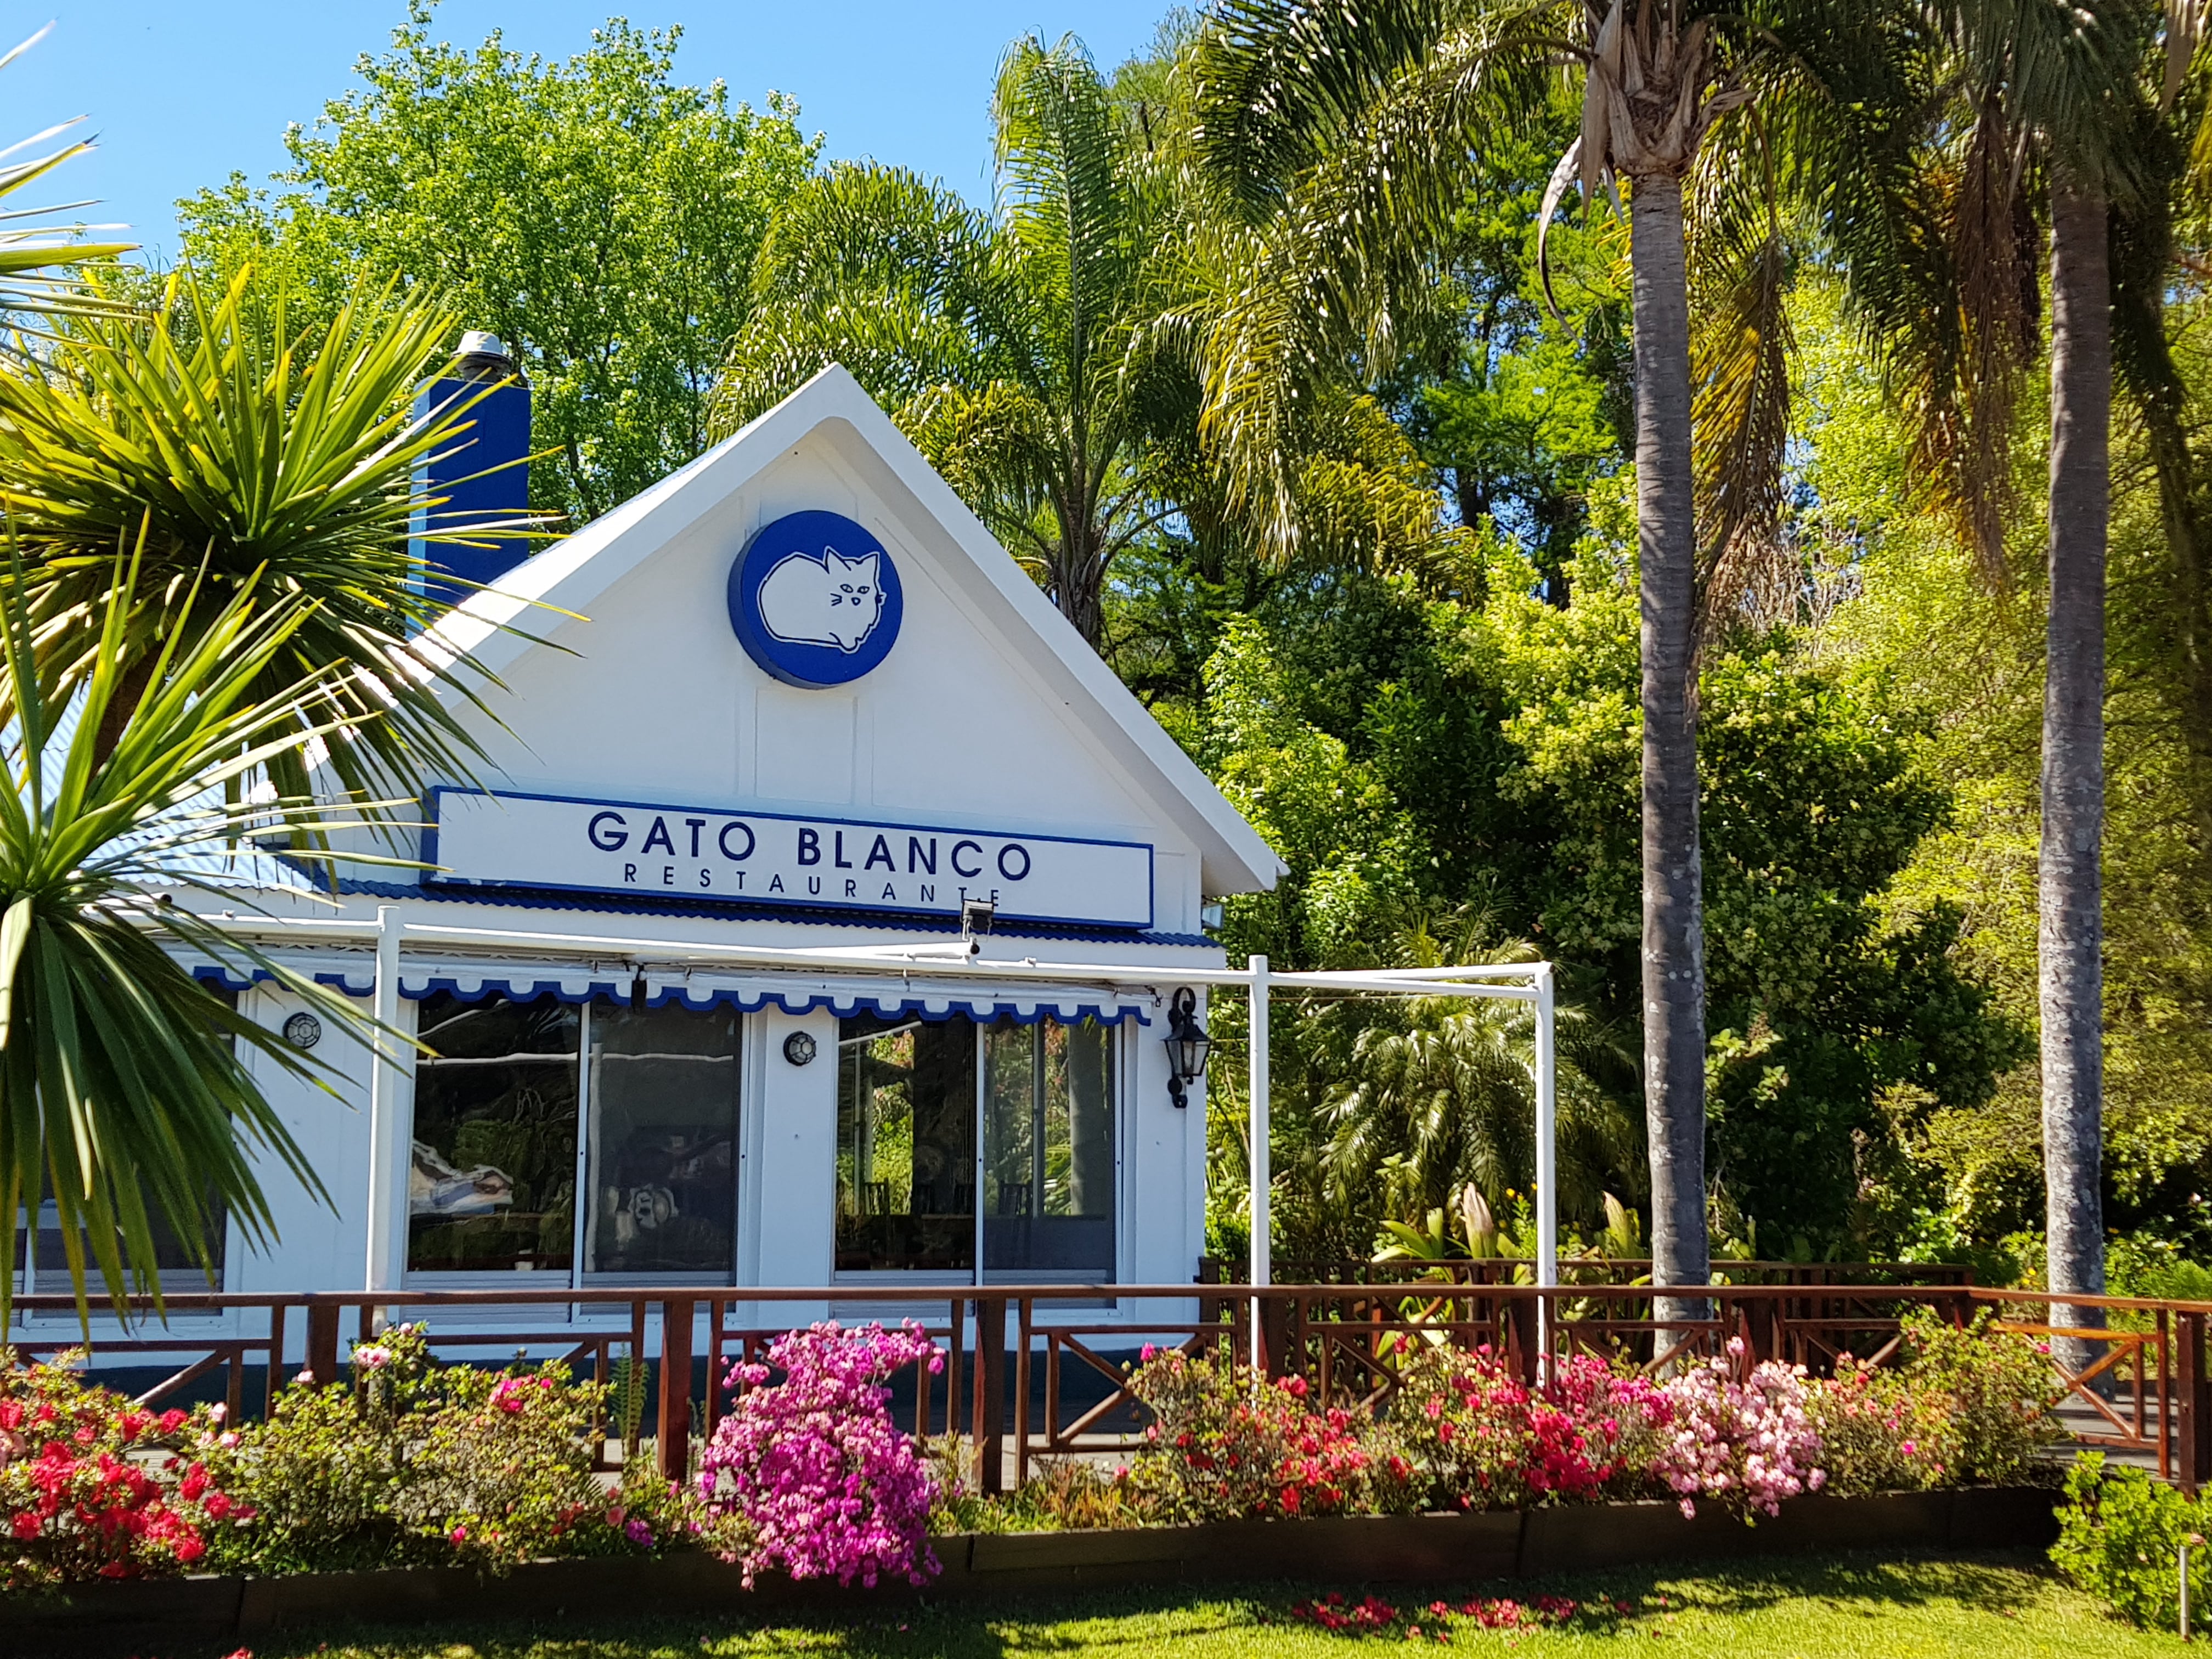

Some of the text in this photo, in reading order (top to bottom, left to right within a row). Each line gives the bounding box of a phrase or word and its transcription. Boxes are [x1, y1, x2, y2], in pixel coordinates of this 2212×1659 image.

[588, 811, 1031, 881] GATO BLANCO
[624, 863, 998, 906] RESTAURANTE
